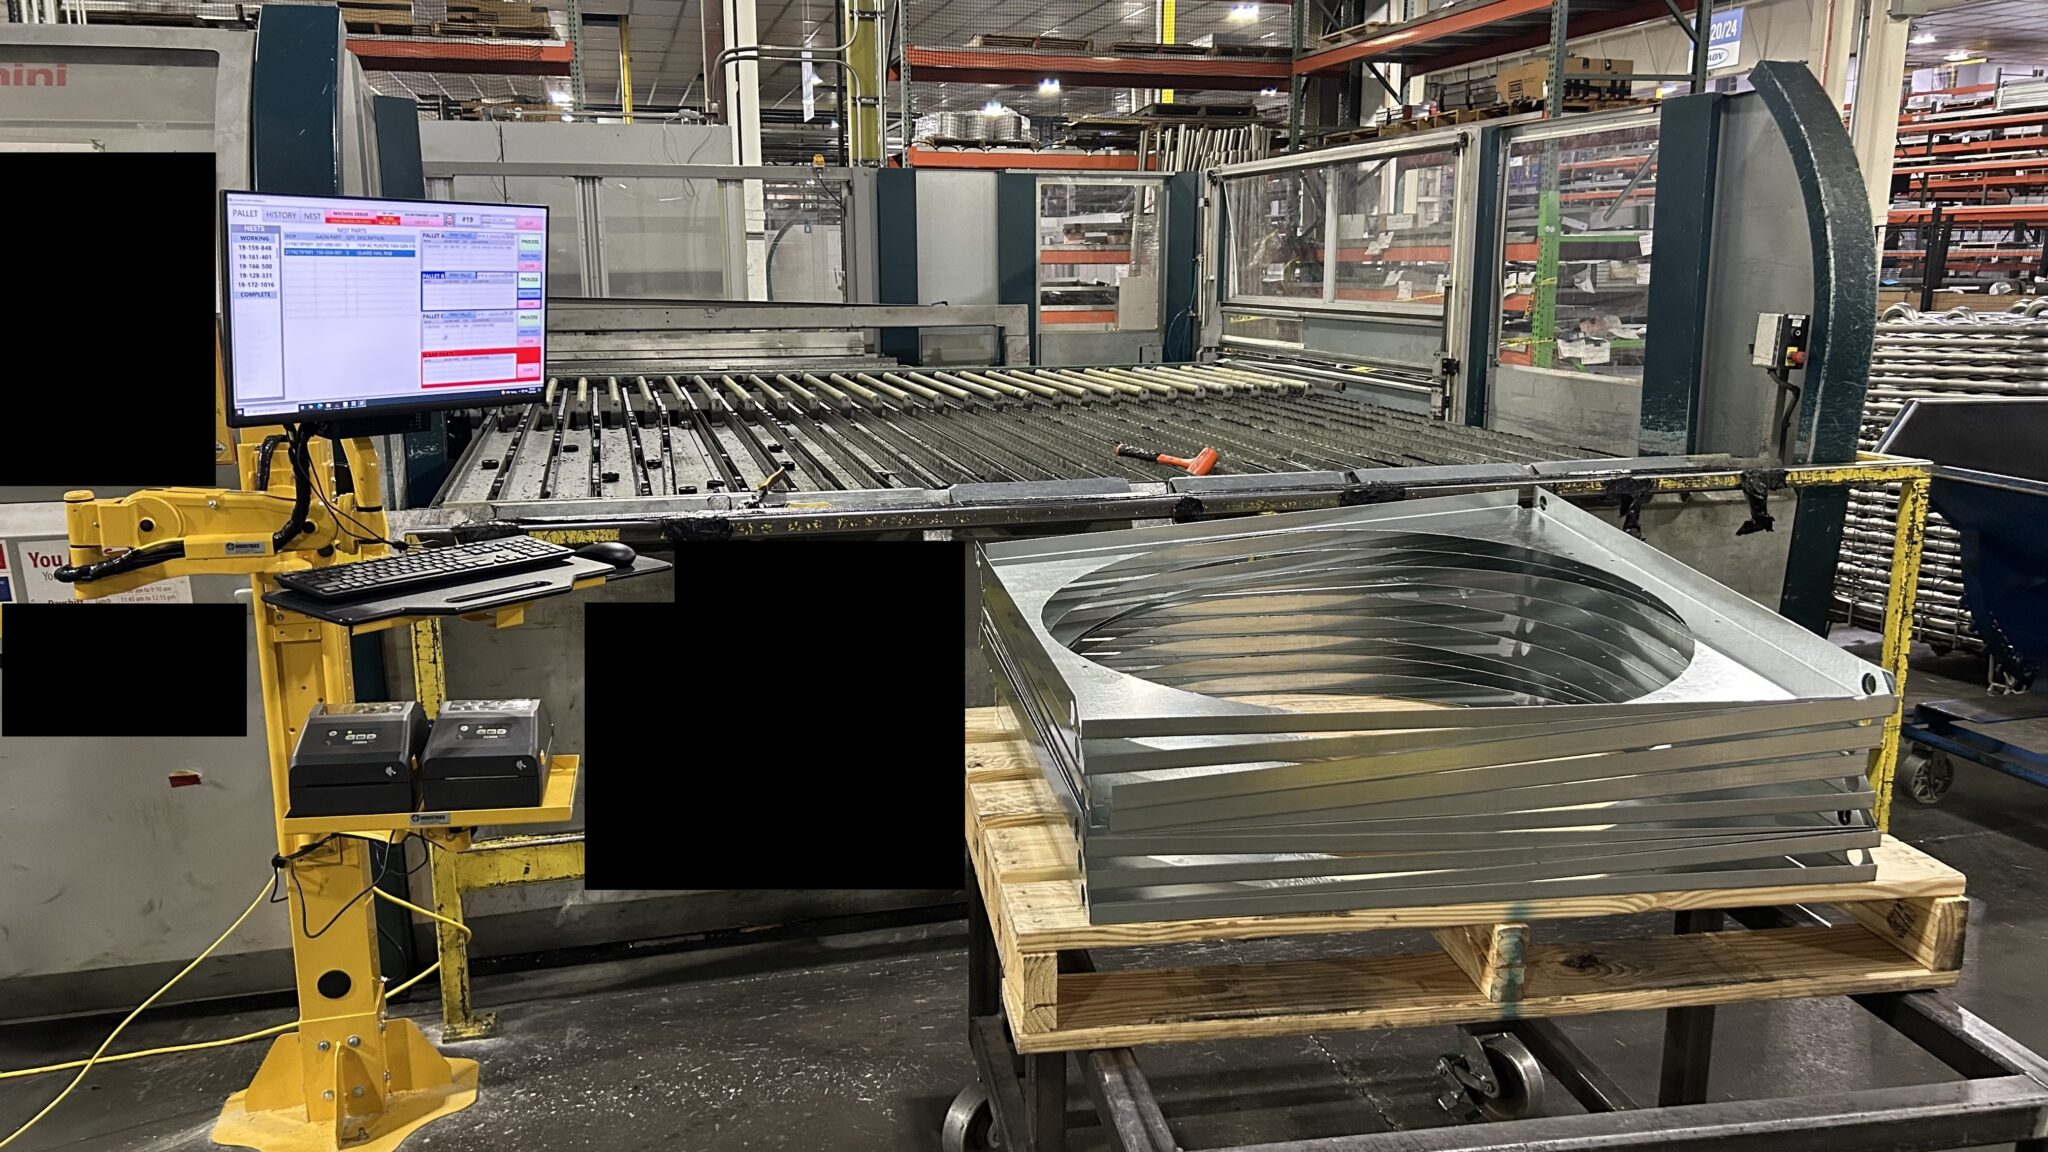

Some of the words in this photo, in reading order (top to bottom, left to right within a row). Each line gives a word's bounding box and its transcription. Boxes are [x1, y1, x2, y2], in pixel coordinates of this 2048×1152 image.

[1710, 19, 1738, 41] 20/24
[232, 209, 259, 218] PALLET
[266, 211, 297, 220] HISTORY
[303, 212, 321, 221] NEST
[27, 552, 62, 569] You
[42, 571, 53, 581] Yo
[167, 594, 177, 602] pm
